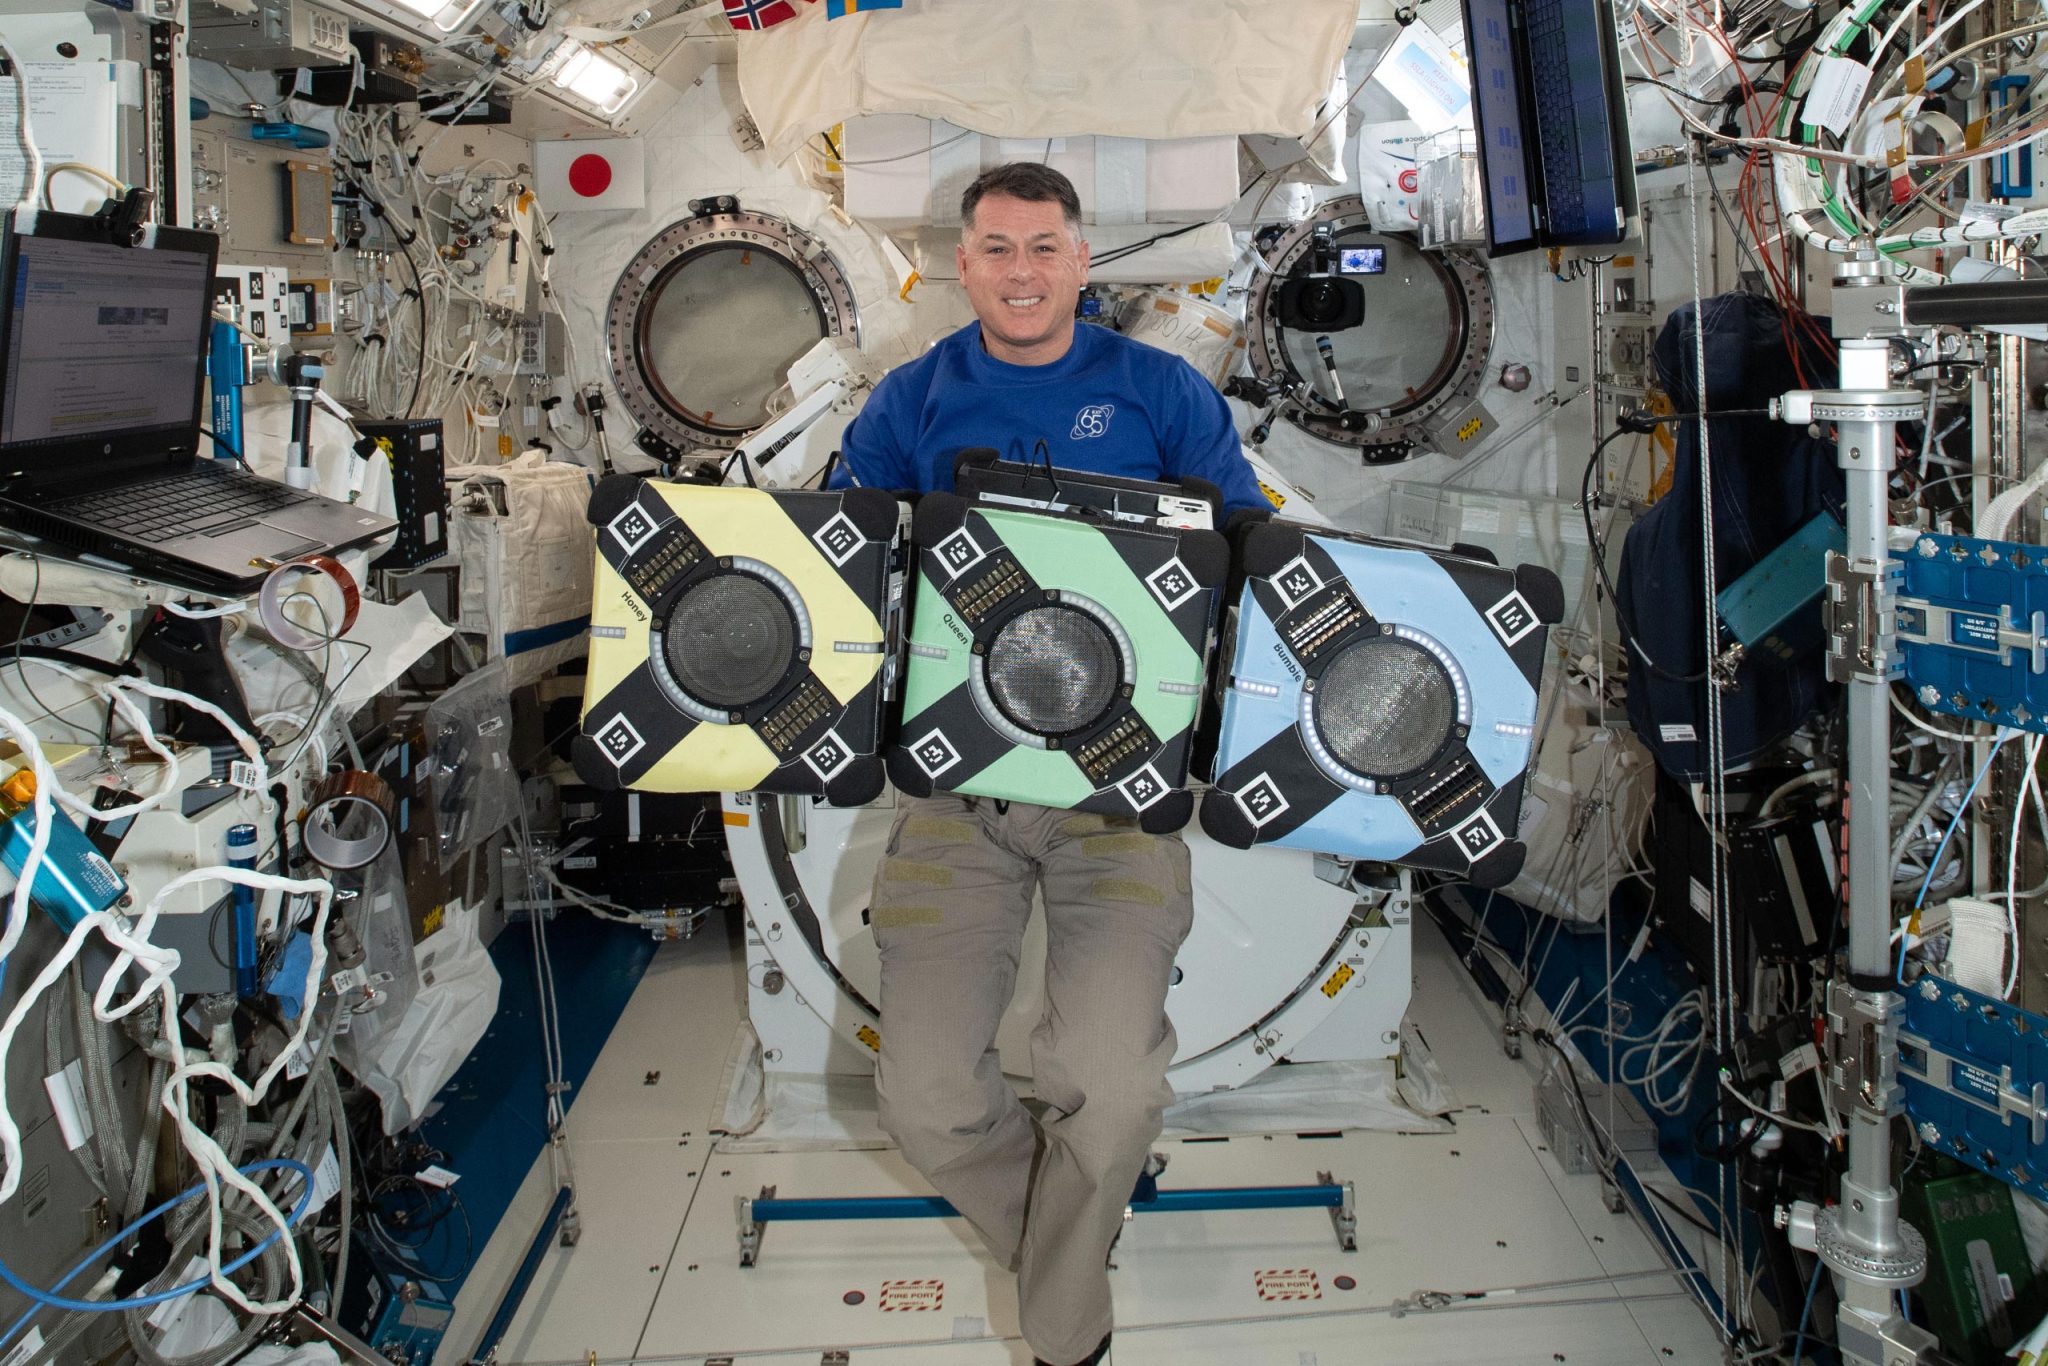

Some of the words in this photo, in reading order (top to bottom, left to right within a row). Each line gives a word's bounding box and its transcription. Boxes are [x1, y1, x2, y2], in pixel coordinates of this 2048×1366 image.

[1080, 408, 1103, 434] 65
[621, 590, 648, 622] Honey
[943, 613, 968, 645] Queen
[1273, 643, 1302, 682] Bumble
